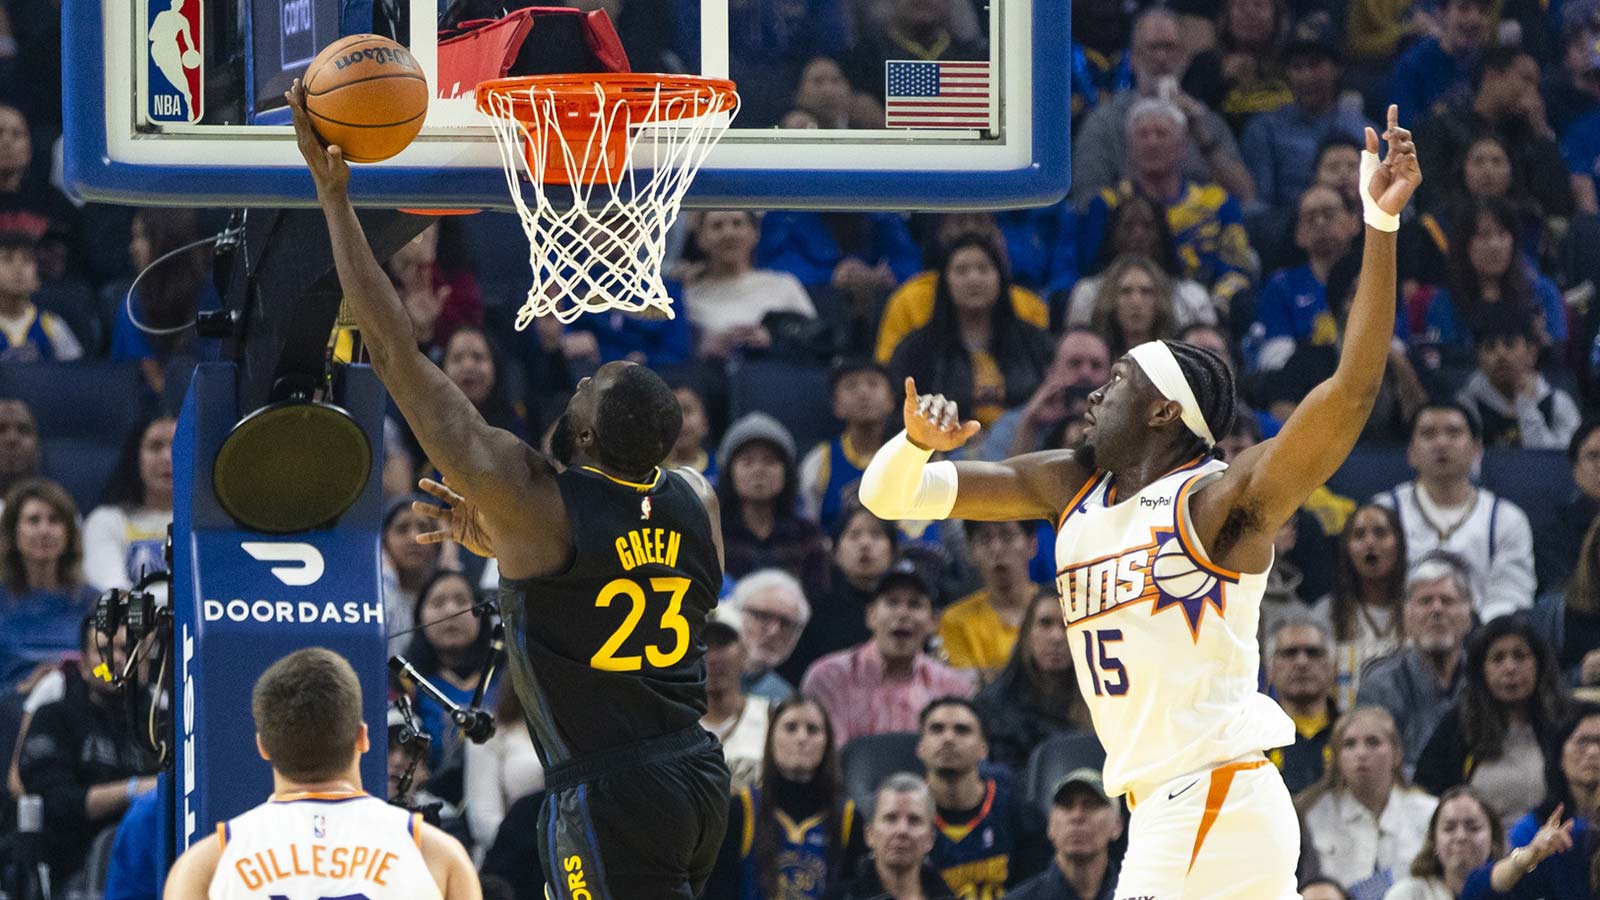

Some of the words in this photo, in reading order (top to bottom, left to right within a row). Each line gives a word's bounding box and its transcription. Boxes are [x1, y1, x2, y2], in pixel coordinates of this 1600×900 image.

[334, 46, 416, 71] Wilson
[154, 94, 182, 116] NBA
[1140, 495, 1172, 510] PayPal
[614, 527, 681, 571] GREEN
[203, 599, 384, 624] DOORDASH
[590, 577, 692, 672] 23
[1081, 628, 1130, 698] 15
[235, 843, 400, 891] GILLESPIE
